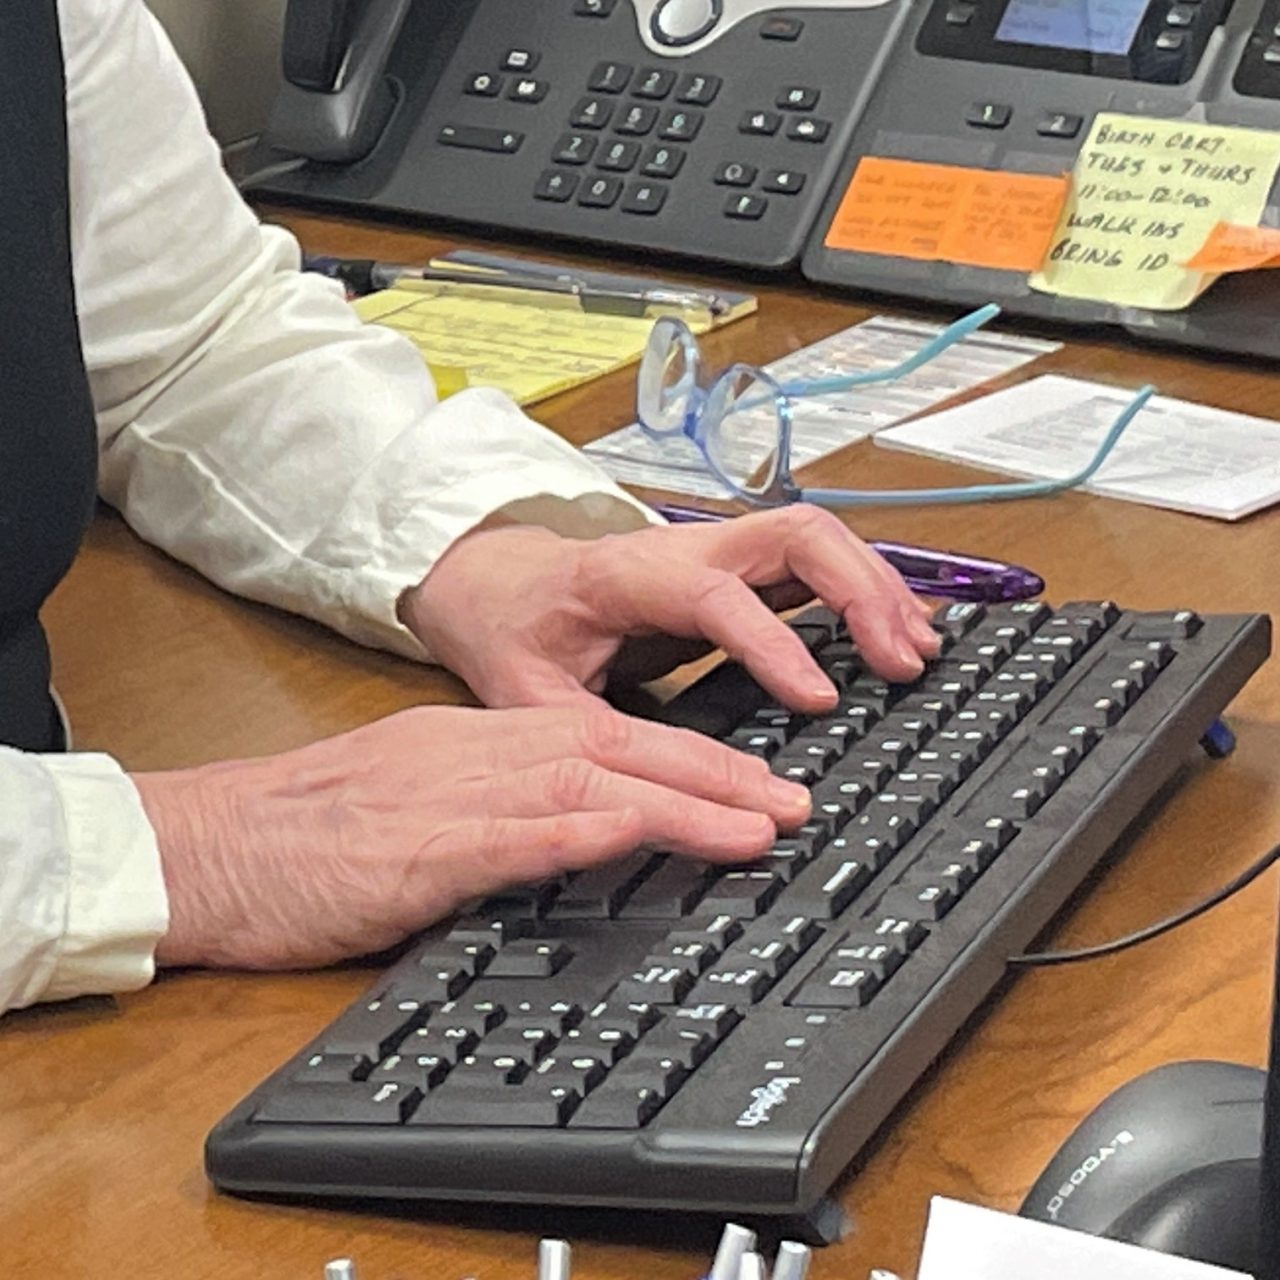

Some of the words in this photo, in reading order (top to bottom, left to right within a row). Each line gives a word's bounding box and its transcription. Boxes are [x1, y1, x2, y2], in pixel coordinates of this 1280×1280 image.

[1096, 124, 1156, 146] BIRTH
[1087, 152, 1146, 177] TUES
[1180, 158, 1258, 186] THURS
[1067, 213, 1138, 236] WALK
[1141, 221, 1185, 240] INS
[1050, 238, 1124, 268] BRING
[1137, 253, 1170, 271] ID
